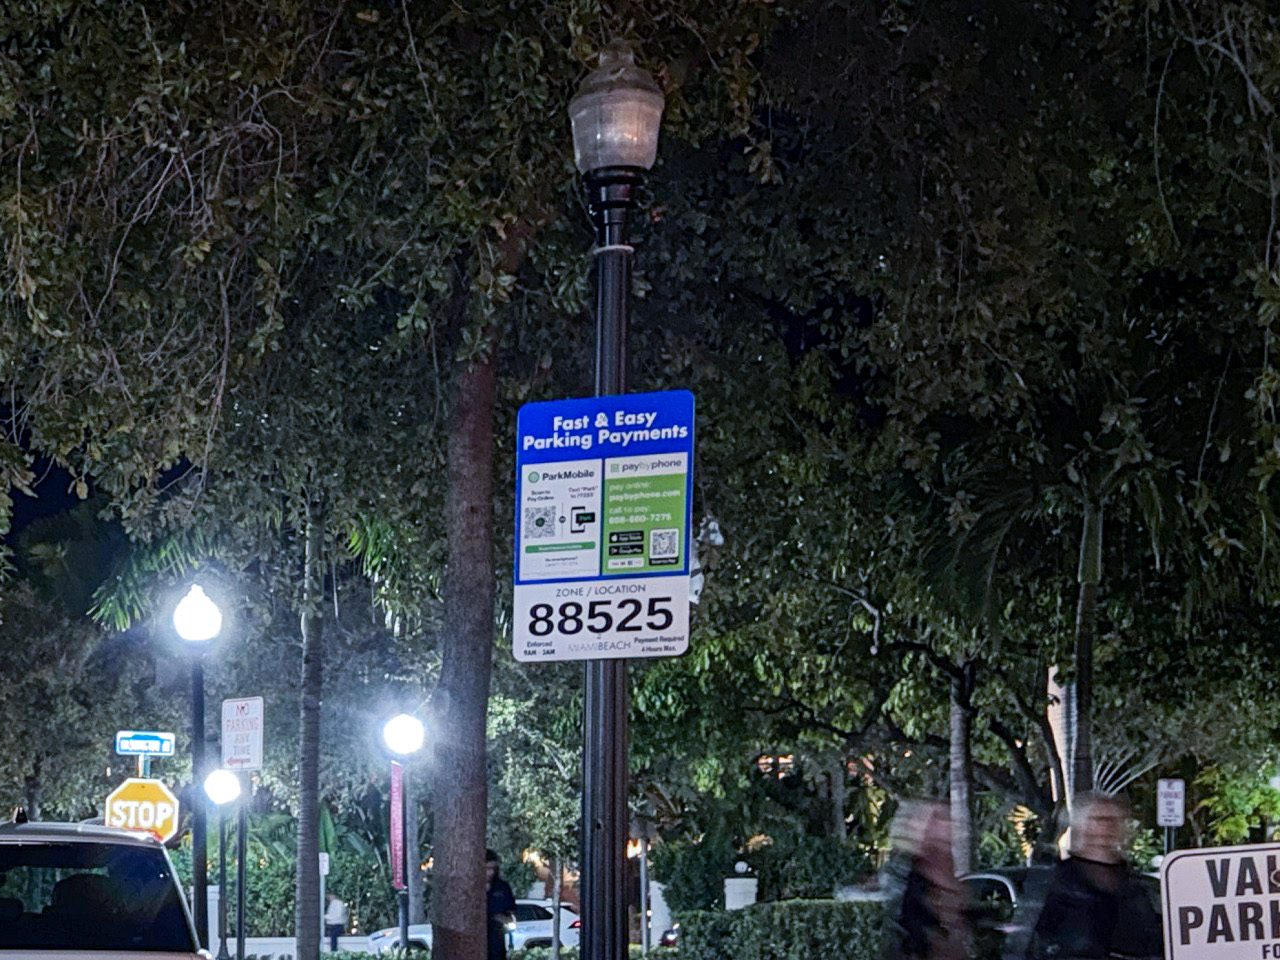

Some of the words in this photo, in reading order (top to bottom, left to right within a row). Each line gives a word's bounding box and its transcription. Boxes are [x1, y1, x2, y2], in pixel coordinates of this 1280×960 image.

[553, 415, 590, 431] Fast
[594, 412, 609, 428] &
[615, 410, 657, 428] Easy
[523, 431, 593, 451] Parking
[598, 425, 688, 447] Payments
[622, 459, 682, 473] paybyphone
[542, 470, 595, 481] ParkMobile
[556, 586, 584, 598] ZONE
[586, 586, 593, 597] /
[594, 584, 646, 595] LOCATION
[528, 596, 673, 637] 88525
[235, 702, 250, 716] NO
[226, 716, 259, 733] PARKING
[234, 733, 250, 744] ANY
[233, 744, 251, 756] TIME
[110, 800, 174, 828] STOP
